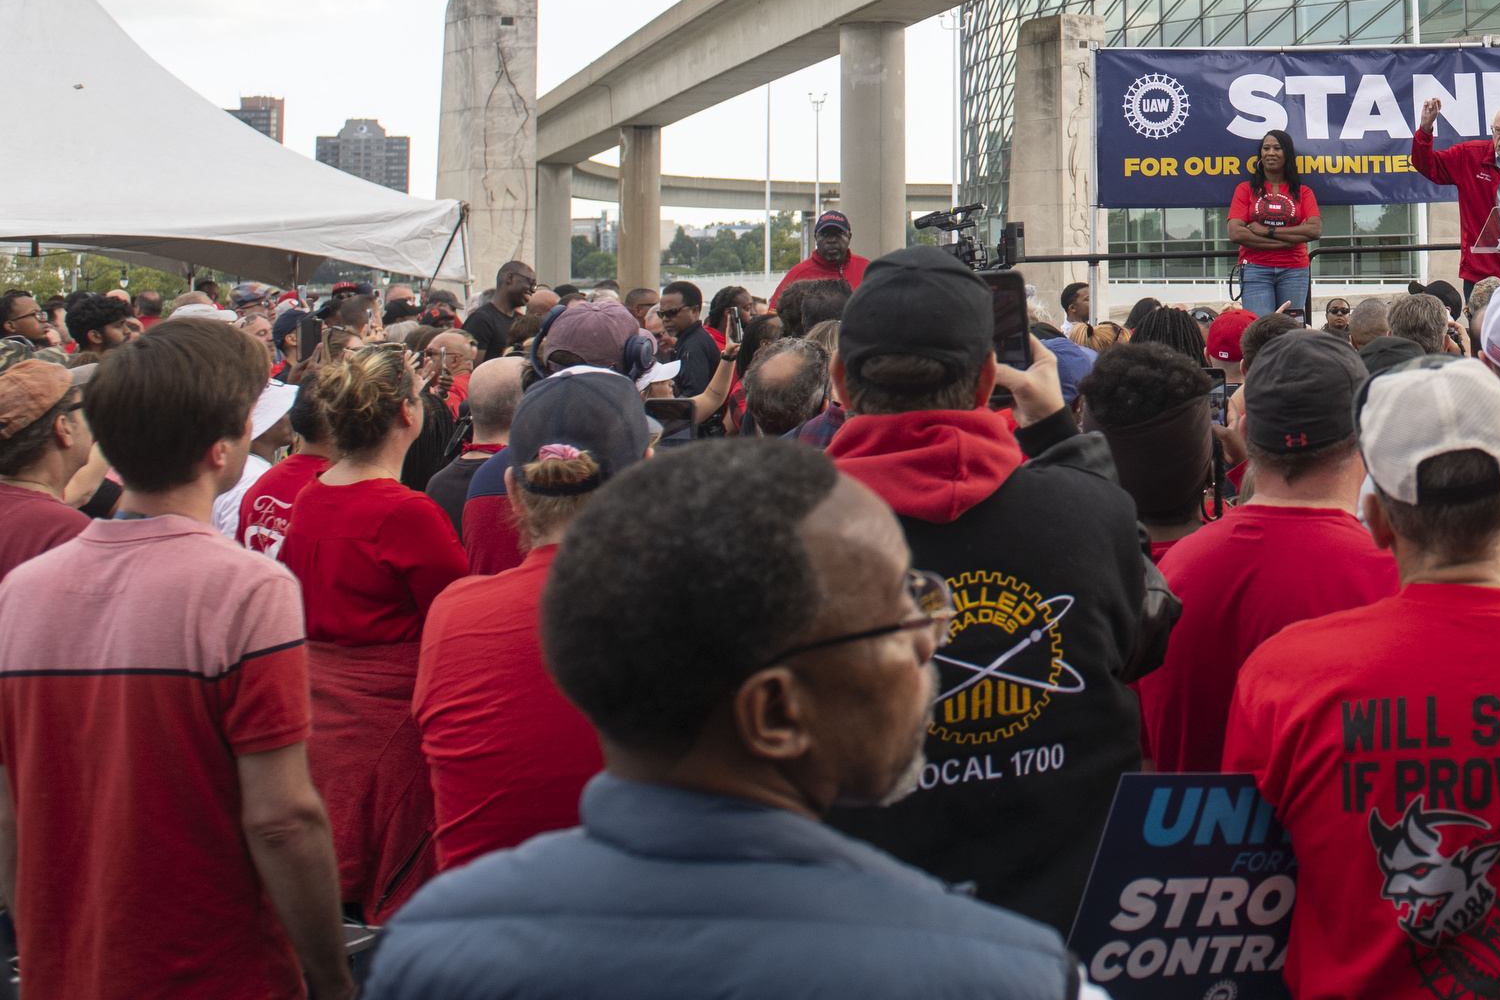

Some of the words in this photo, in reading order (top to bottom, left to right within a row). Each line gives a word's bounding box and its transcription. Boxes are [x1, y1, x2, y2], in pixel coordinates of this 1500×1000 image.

[1142, 98, 1170, 113] UAW
[1124, 157, 1179, 177] FOR
[1184, 156, 1240, 176] OUR
[947, 609, 1019, 644] RADES
[952, 586, 1036, 626] ILLED
[944, 679, 1031, 723] UAW
[1341, 695, 1451, 752] WILL
[915, 754, 1003, 790] OCAL
[1010, 743, 1065, 777] 1700
[1342, 762, 1380, 813] IF
[1231, 852, 1283, 872] FOR
[1109, 875, 1297, 932] STRO
[1444, 884, 1497, 936] 1284
